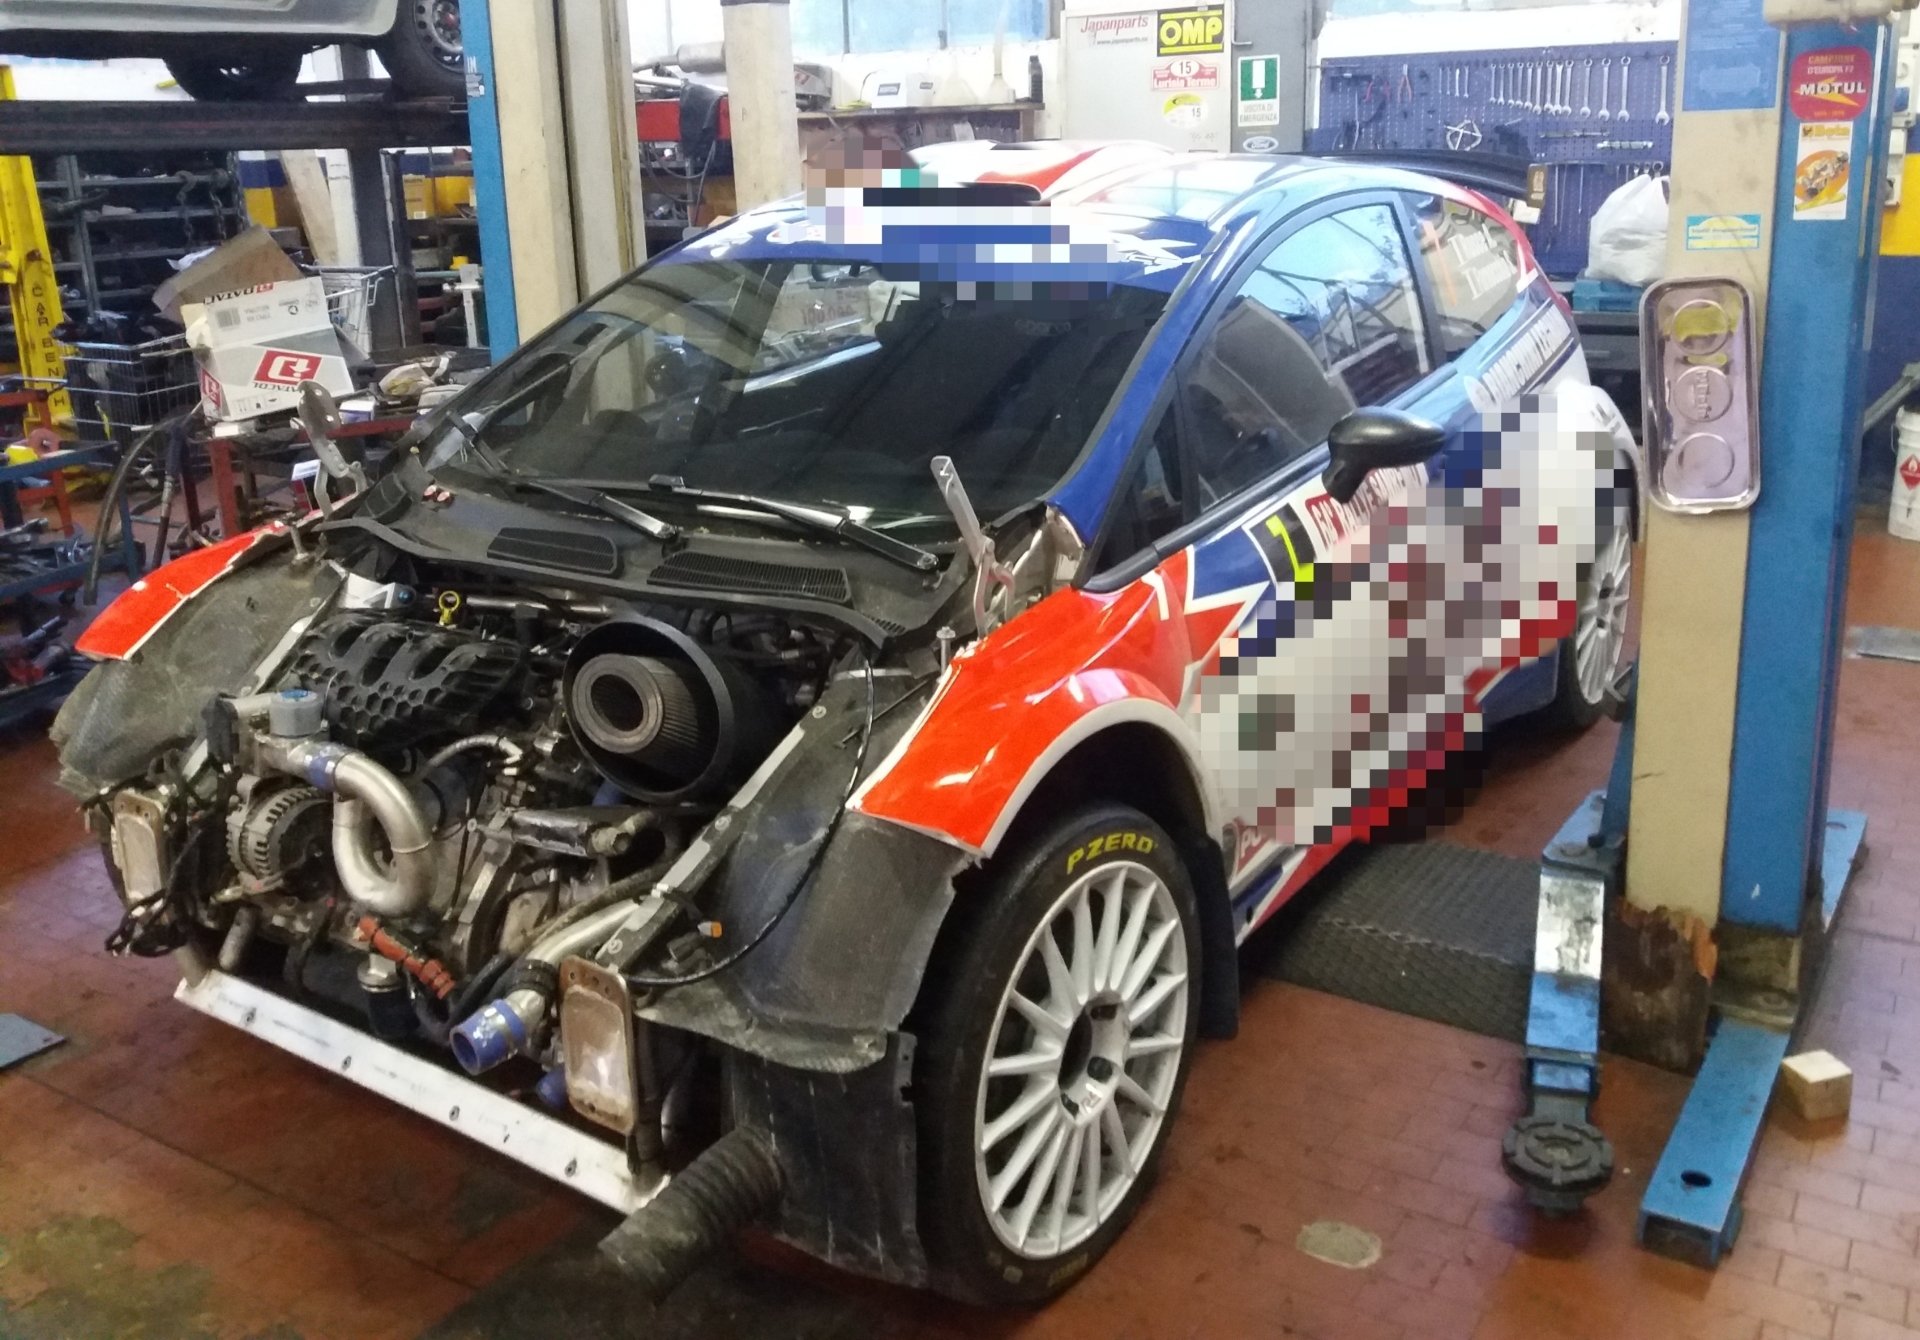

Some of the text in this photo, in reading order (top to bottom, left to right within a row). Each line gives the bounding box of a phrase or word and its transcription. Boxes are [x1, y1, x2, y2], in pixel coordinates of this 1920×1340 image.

[1080, 14, 1149, 36] Japanparts
[1160, 16, 1223, 46] OMP
[1179, 61, 1192, 75] 15
[1799, 81, 1867, 96] MOTUL
[1192, 107, 1202, 118] 15
[42, 338, 65, 407] BENH
